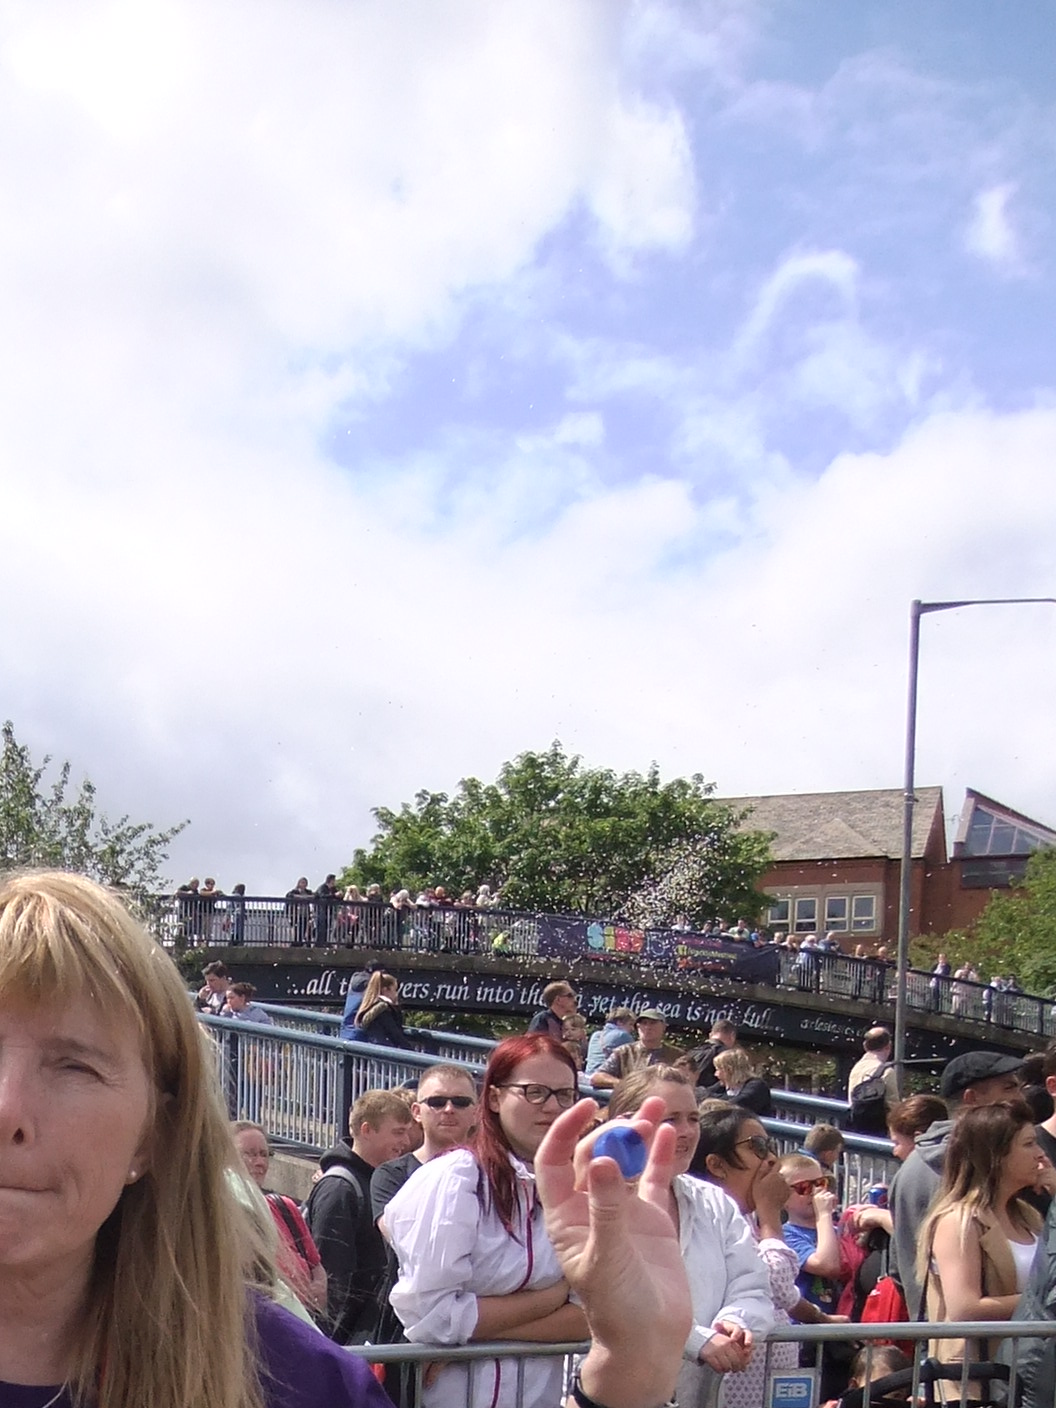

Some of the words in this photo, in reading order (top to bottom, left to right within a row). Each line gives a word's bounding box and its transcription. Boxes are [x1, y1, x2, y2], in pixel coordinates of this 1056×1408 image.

[435, 983, 471, 1002] run
[476, 980, 514, 1005] into
[656, 1001, 681, 1018] sea
[686, 1000, 702, 1022] is
